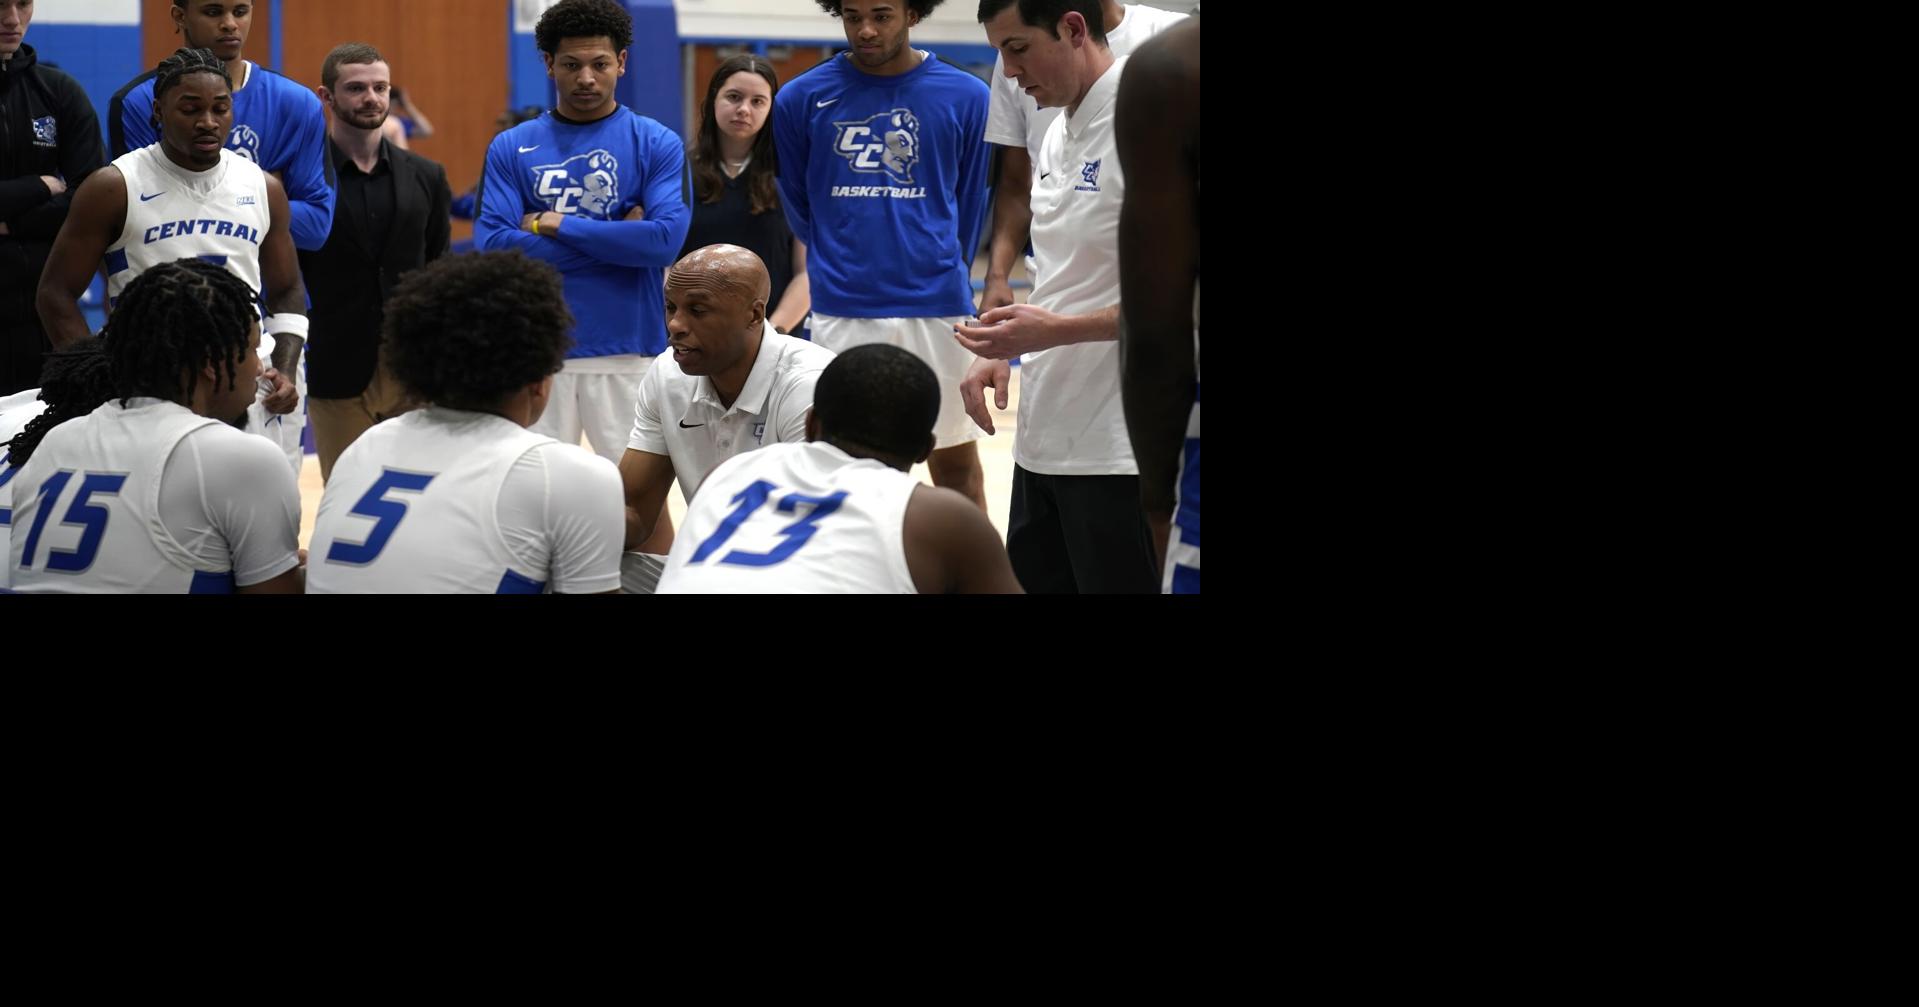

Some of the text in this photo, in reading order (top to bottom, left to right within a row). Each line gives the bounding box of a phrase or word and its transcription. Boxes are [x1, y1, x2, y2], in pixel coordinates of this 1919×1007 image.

[840, 126, 884, 168] CC
[538, 169, 584, 213] CC
[831, 186, 927, 199] BASKETBALL
[143, 219, 258, 246] CENTRAL
[19, 467, 131, 576] 15
[324, 465, 441, 569] 5
[684, 478, 852, 569] 13
